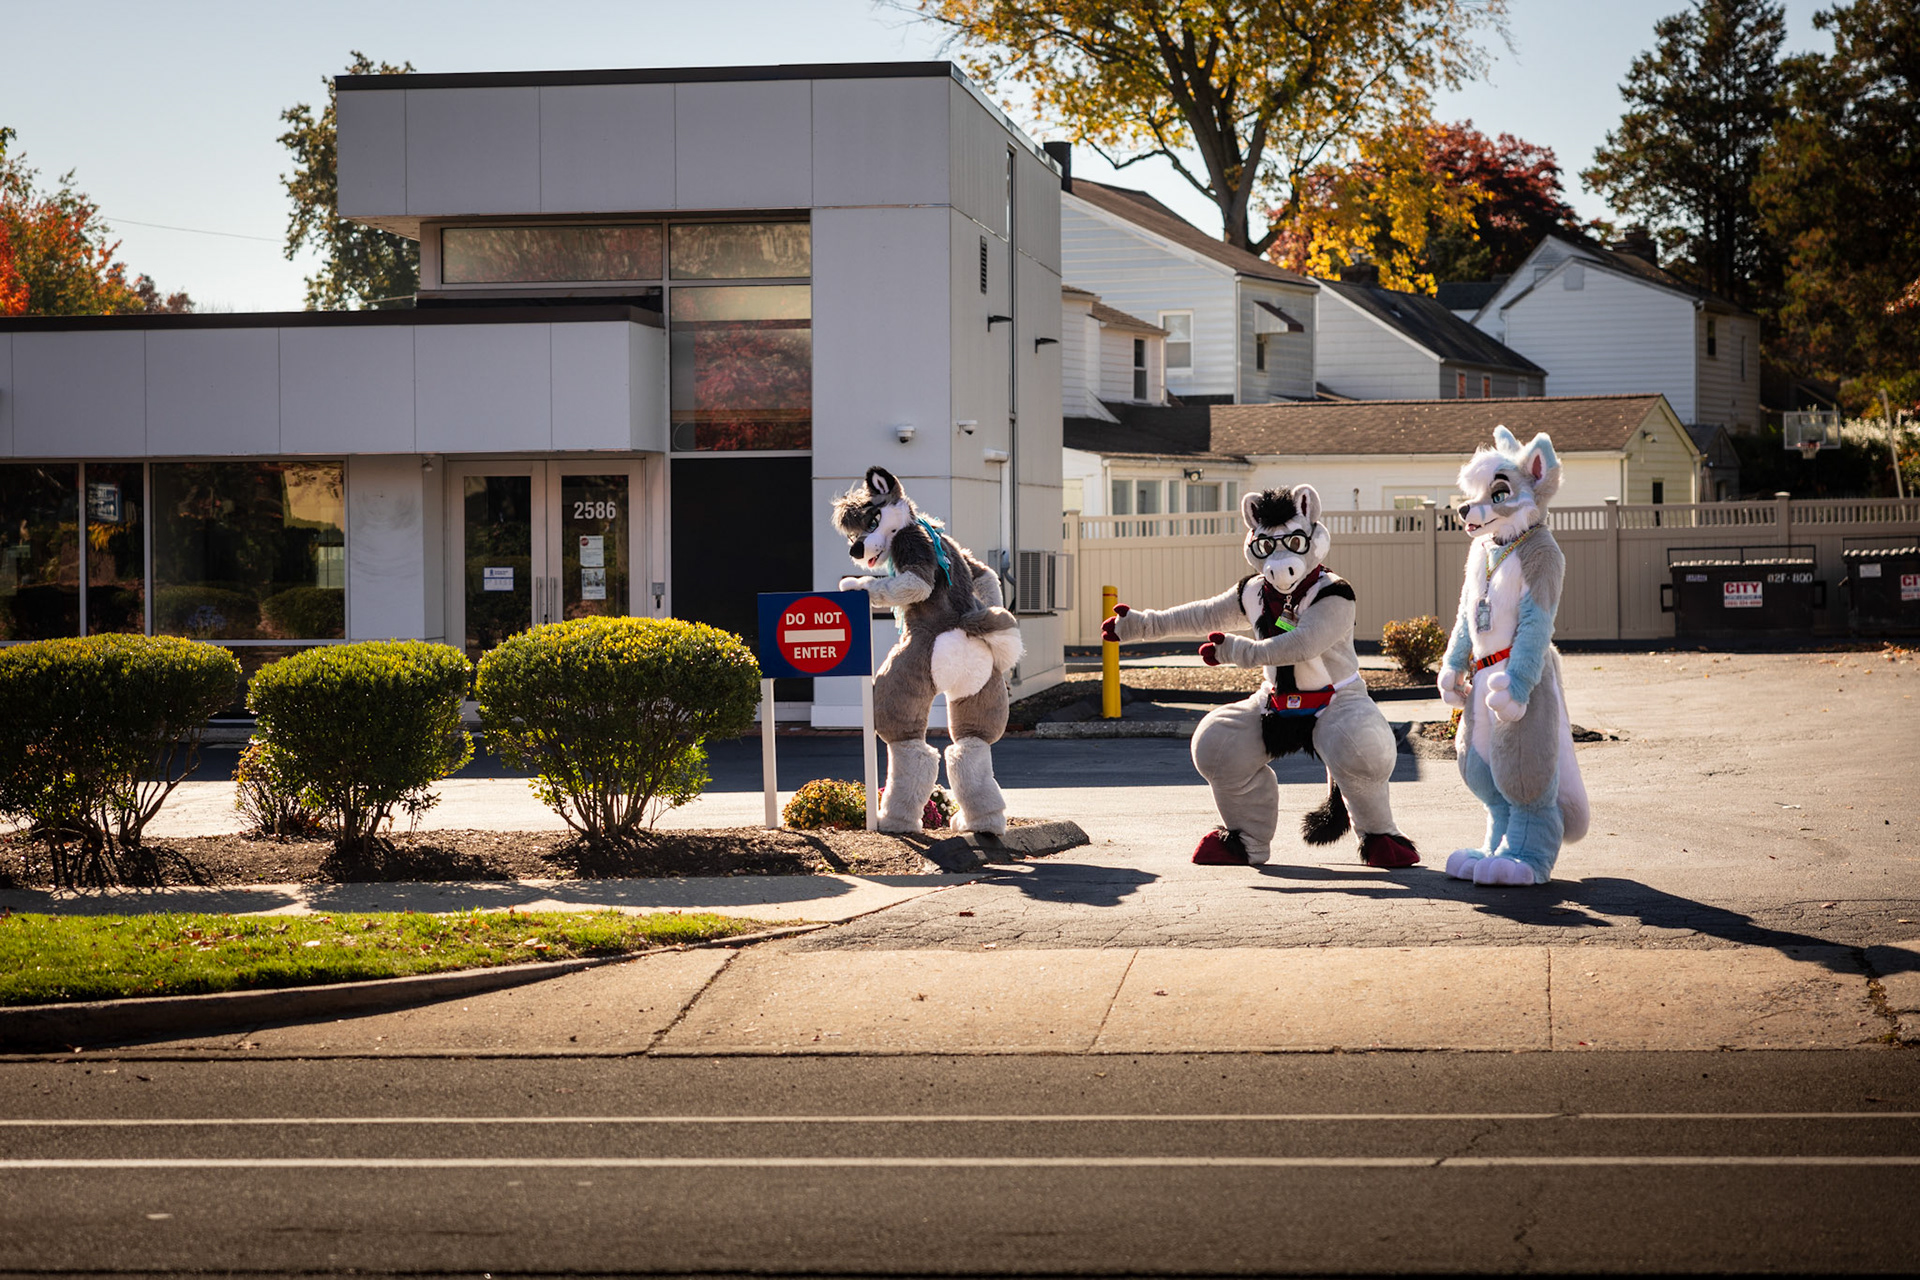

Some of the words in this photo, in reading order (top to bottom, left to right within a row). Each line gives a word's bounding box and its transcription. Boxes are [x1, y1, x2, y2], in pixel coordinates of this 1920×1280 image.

[574, 501, 616, 519] 2586
[1902, 575, 1920, 587] CI
[1725, 582, 1760, 594] CITY
[786, 613, 806, 625] DO
[814, 612, 842, 624] NOT
[794, 646, 837, 659] ENTER
